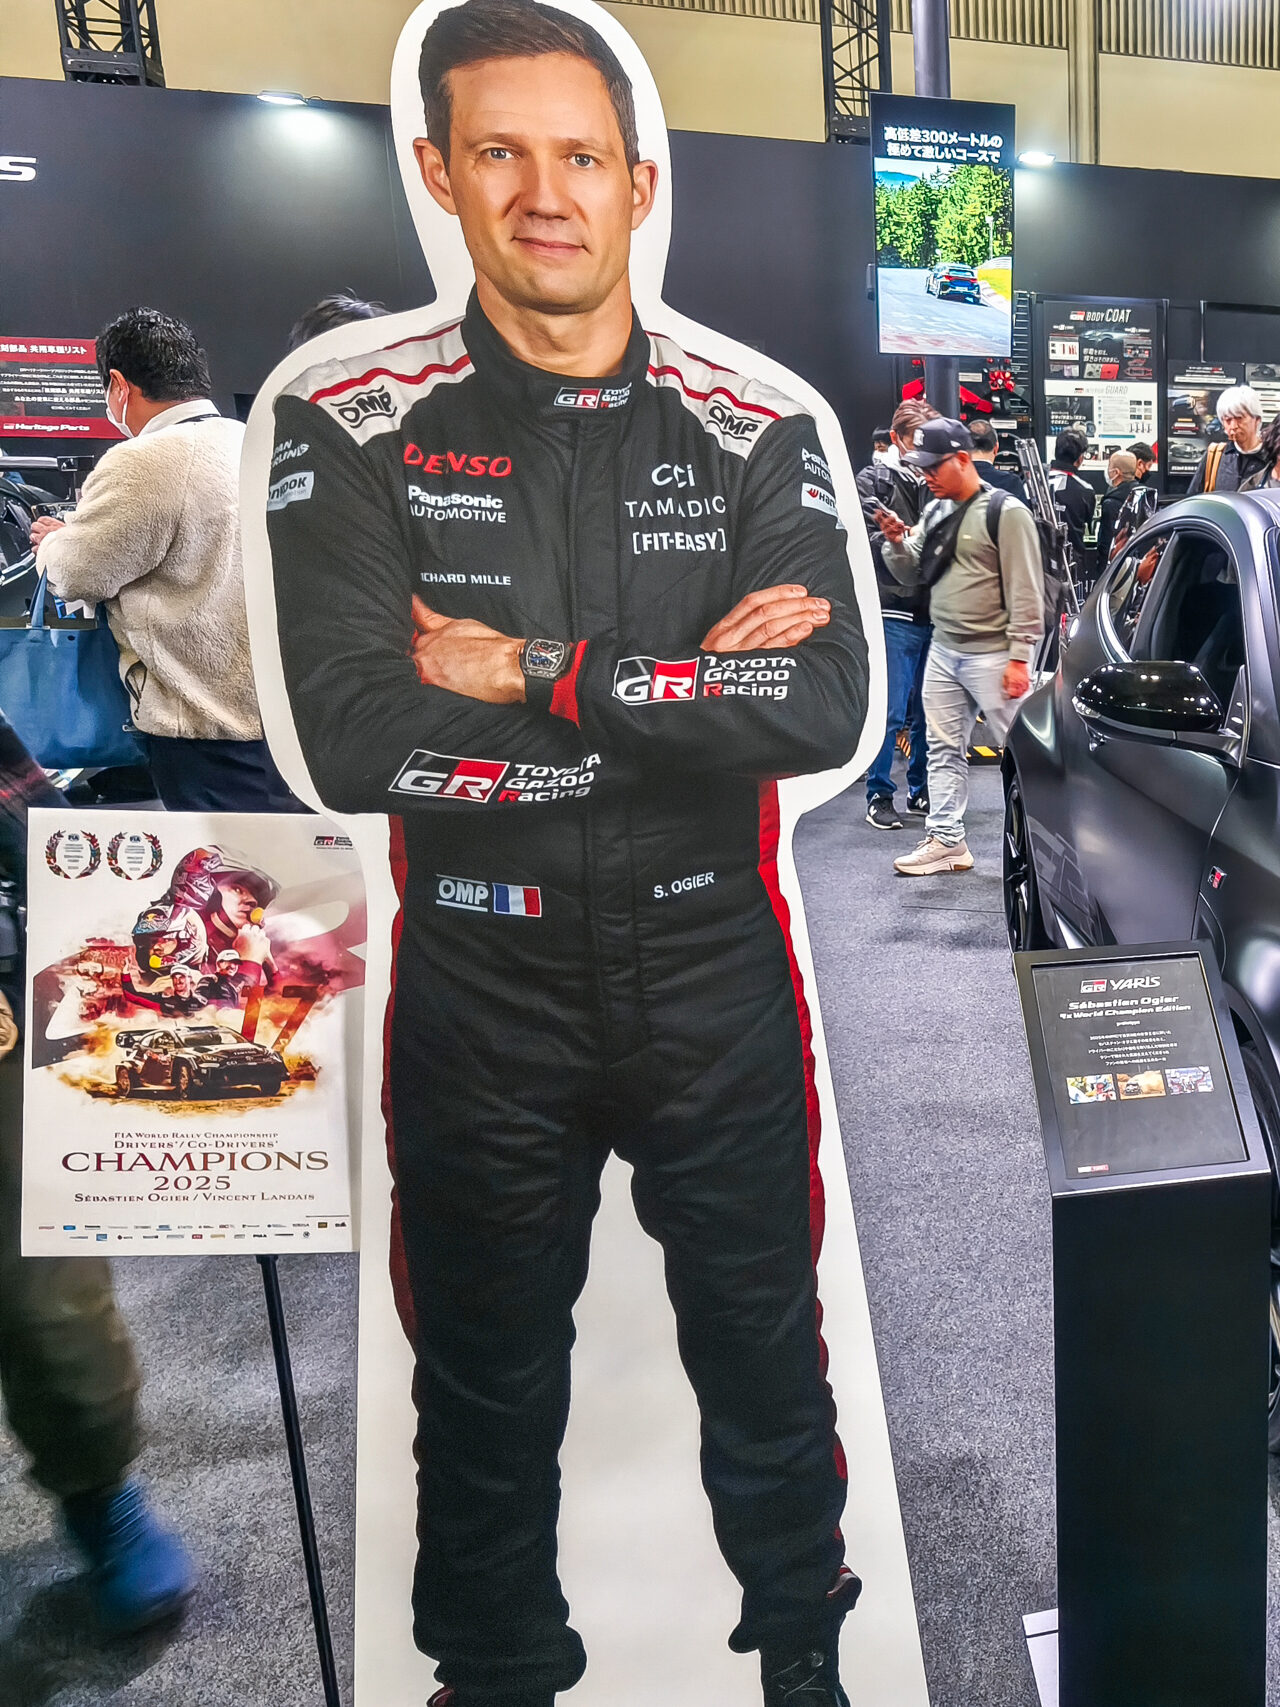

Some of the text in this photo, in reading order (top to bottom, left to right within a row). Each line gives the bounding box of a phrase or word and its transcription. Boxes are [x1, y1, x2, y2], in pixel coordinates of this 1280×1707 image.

[883, 126, 1003, 148] 高低差300メートルの
[886, 142, 1001, 164] 極めて激しいコースで
[1085, 310, 1105, 322] BODY
[1105, 308, 1132, 323] COAT
[337, 391, 393, 424] OMP
[556, 391, 599, 407] GR
[708, 405, 759, 436] OMP
[403, 442, 512, 477] DENSO
[407, 484, 504, 509] Panasonic
[470, 573, 512, 586] MILLE
[614, 655, 797, 702] GR TOYOTA
[703, 666, 790, 683] GAZOO
[703, 683, 789, 701] Racing
[395, 752, 602, 800] GR TOYOTA
[504, 771, 595, 790] GAZOO
[498, 785, 591, 802] Racing
[437, 878, 489, 906] OMP
[653, 871, 715, 899] S. OGIER
[1081, 975, 1161, 994] GR YARIS
[1140, 995, 1179, 1006] Ogier
[1073, 1008, 1104, 1019] World
[1104, 1006, 1155, 1016] Champion
[1155, 1004, 1192, 1013] Edition
[61, 1151, 329, 1172] CHAMPIONS
[153, 1175, 231, 1190] 2025
[148, 1192, 190, 1202] OGIER
[202, 1192, 257, 1202] VINCENT
[260, 1192, 316, 1201] LANDAIS
